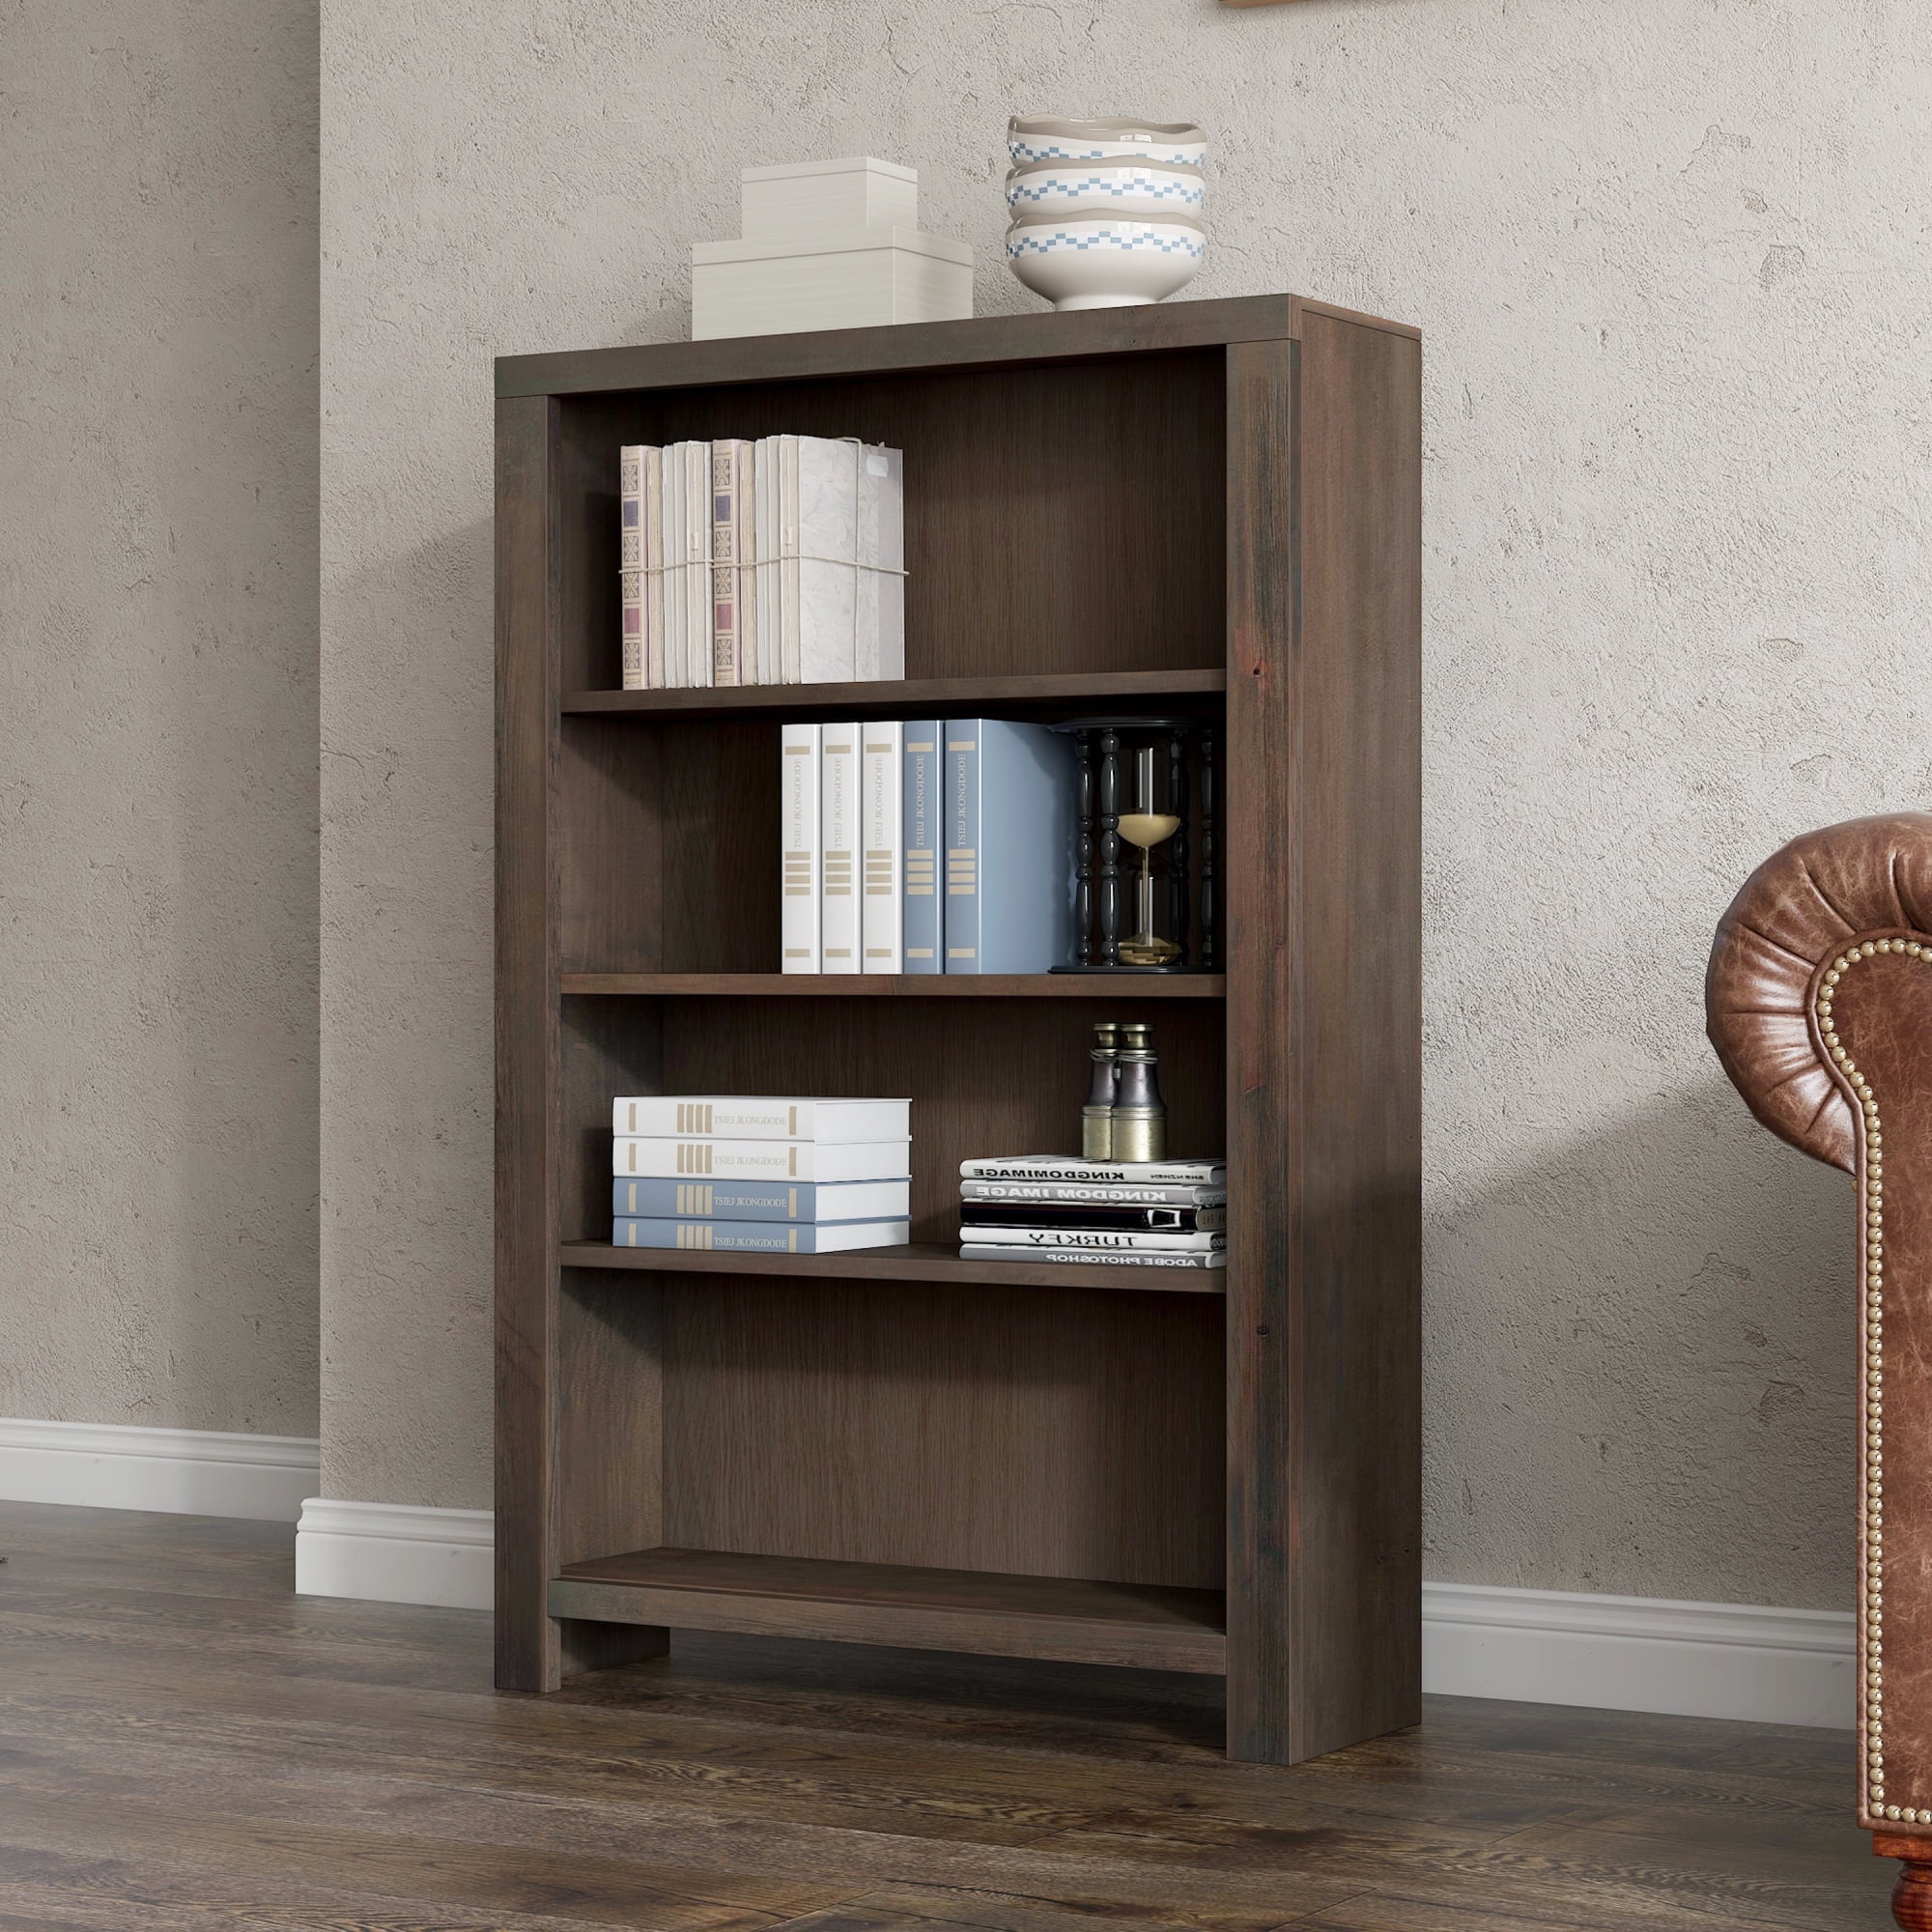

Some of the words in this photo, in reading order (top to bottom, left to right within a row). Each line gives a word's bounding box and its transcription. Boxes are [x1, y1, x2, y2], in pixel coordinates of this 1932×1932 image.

[714, 1197, 734, 1206] TSIEJ
[736, 1198, 787, 1207] JKONGDODE
[714, 1237, 734, 1246] TSIEJ
[736, 1237, 787, 1247] JKONGDODE
